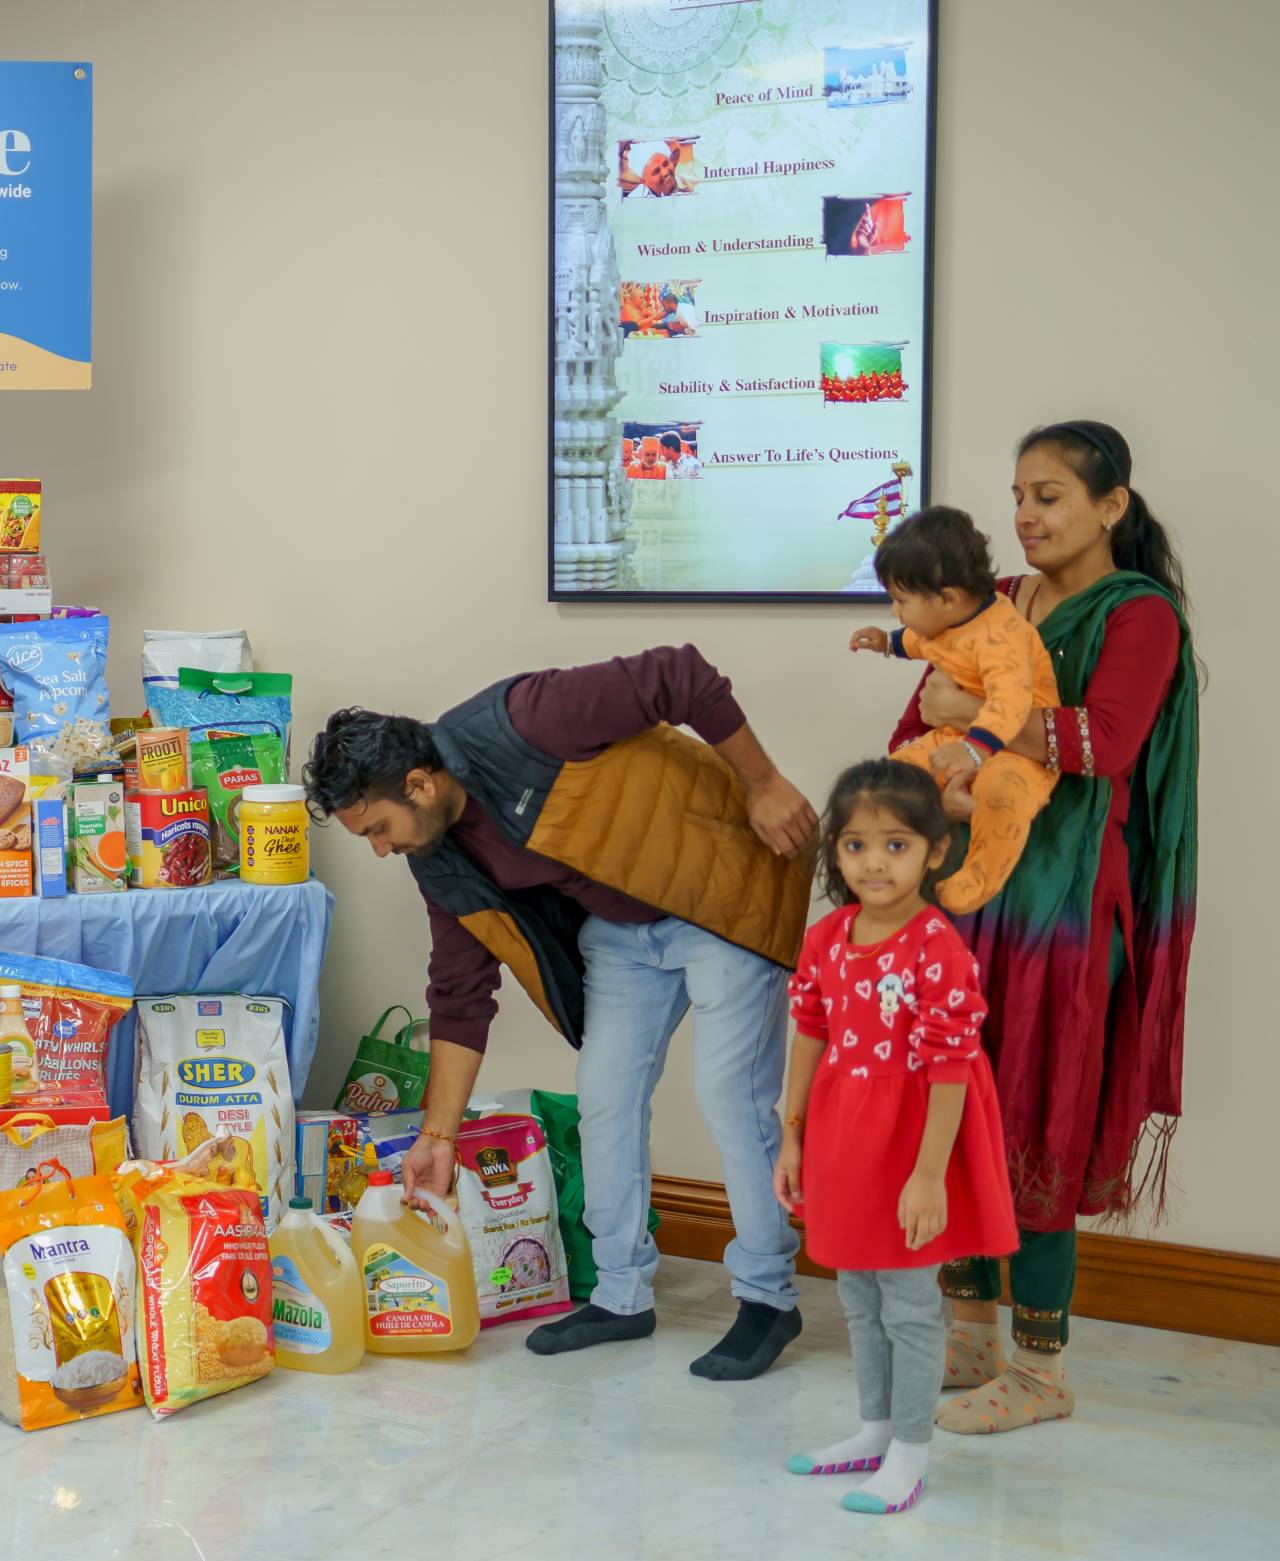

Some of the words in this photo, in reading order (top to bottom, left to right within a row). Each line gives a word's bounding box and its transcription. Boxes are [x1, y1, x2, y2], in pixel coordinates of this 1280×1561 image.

[716, 90, 754, 106] Peace
[758, 88, 773, 101] of
[777, 84, 812, 101] Mind
[704, 162, 760, 180] Internal
[764, 156, 834, 177] Happiness
[638, 242, 690, 256] Wisdom
[695, 241, 706, 253] &
[712, 234, 816, 254] Understanding
[705, 307, 779, 324] Inspiration
[785, 306, 796, 318] &
[802, 302, 878, 318] Motivation
[659, 380, 714, 397] Stability
[719, 380, 730, 392] &
[736, 376, 815, 391] Satisfaction
[710, 451, 761, 465] Answer
[764, 449, 781, 464] To
[787, 449, 824, 462] Life's
[829, 447, 898, 462] Questions
[35, 674, 58, 685] Sea
[62, 672, 88, 683] Salt
[40, 686, 88, 700] Popcorn
[141, 742, 181, 760] FROOTI
[224, 774, 258, 786] PARAS
[162, 797, 207, 816] Unico
[265, 825, 299, 834] NANAK
[264, 842, 301, 857] Ghee
[5, 860, 29, 868] SPICE
[183, 1062, 244, 1083] SHER
[179, 1094, 219, 1104] DURUM
[225, 1094, 258, 1103] ATTA
[218, 1109, 249, 1121] DESI
[482, 1163, 509, 1175] DIVYA
[491, 1194, 524, 1207] Everyday
[30, 1238, 90, 1261] Mantra
[385, 1279, 426, 1292] Saporito
[273, 1298, 322, 1329] Mazola
[386, 1314, 418, 1322] CANOLA
[377, 1321, 401, 1329] HUILE
[151, 1330, 160, 1362] WHEAT
[153, 1365, 162, 1396] FLOUR
